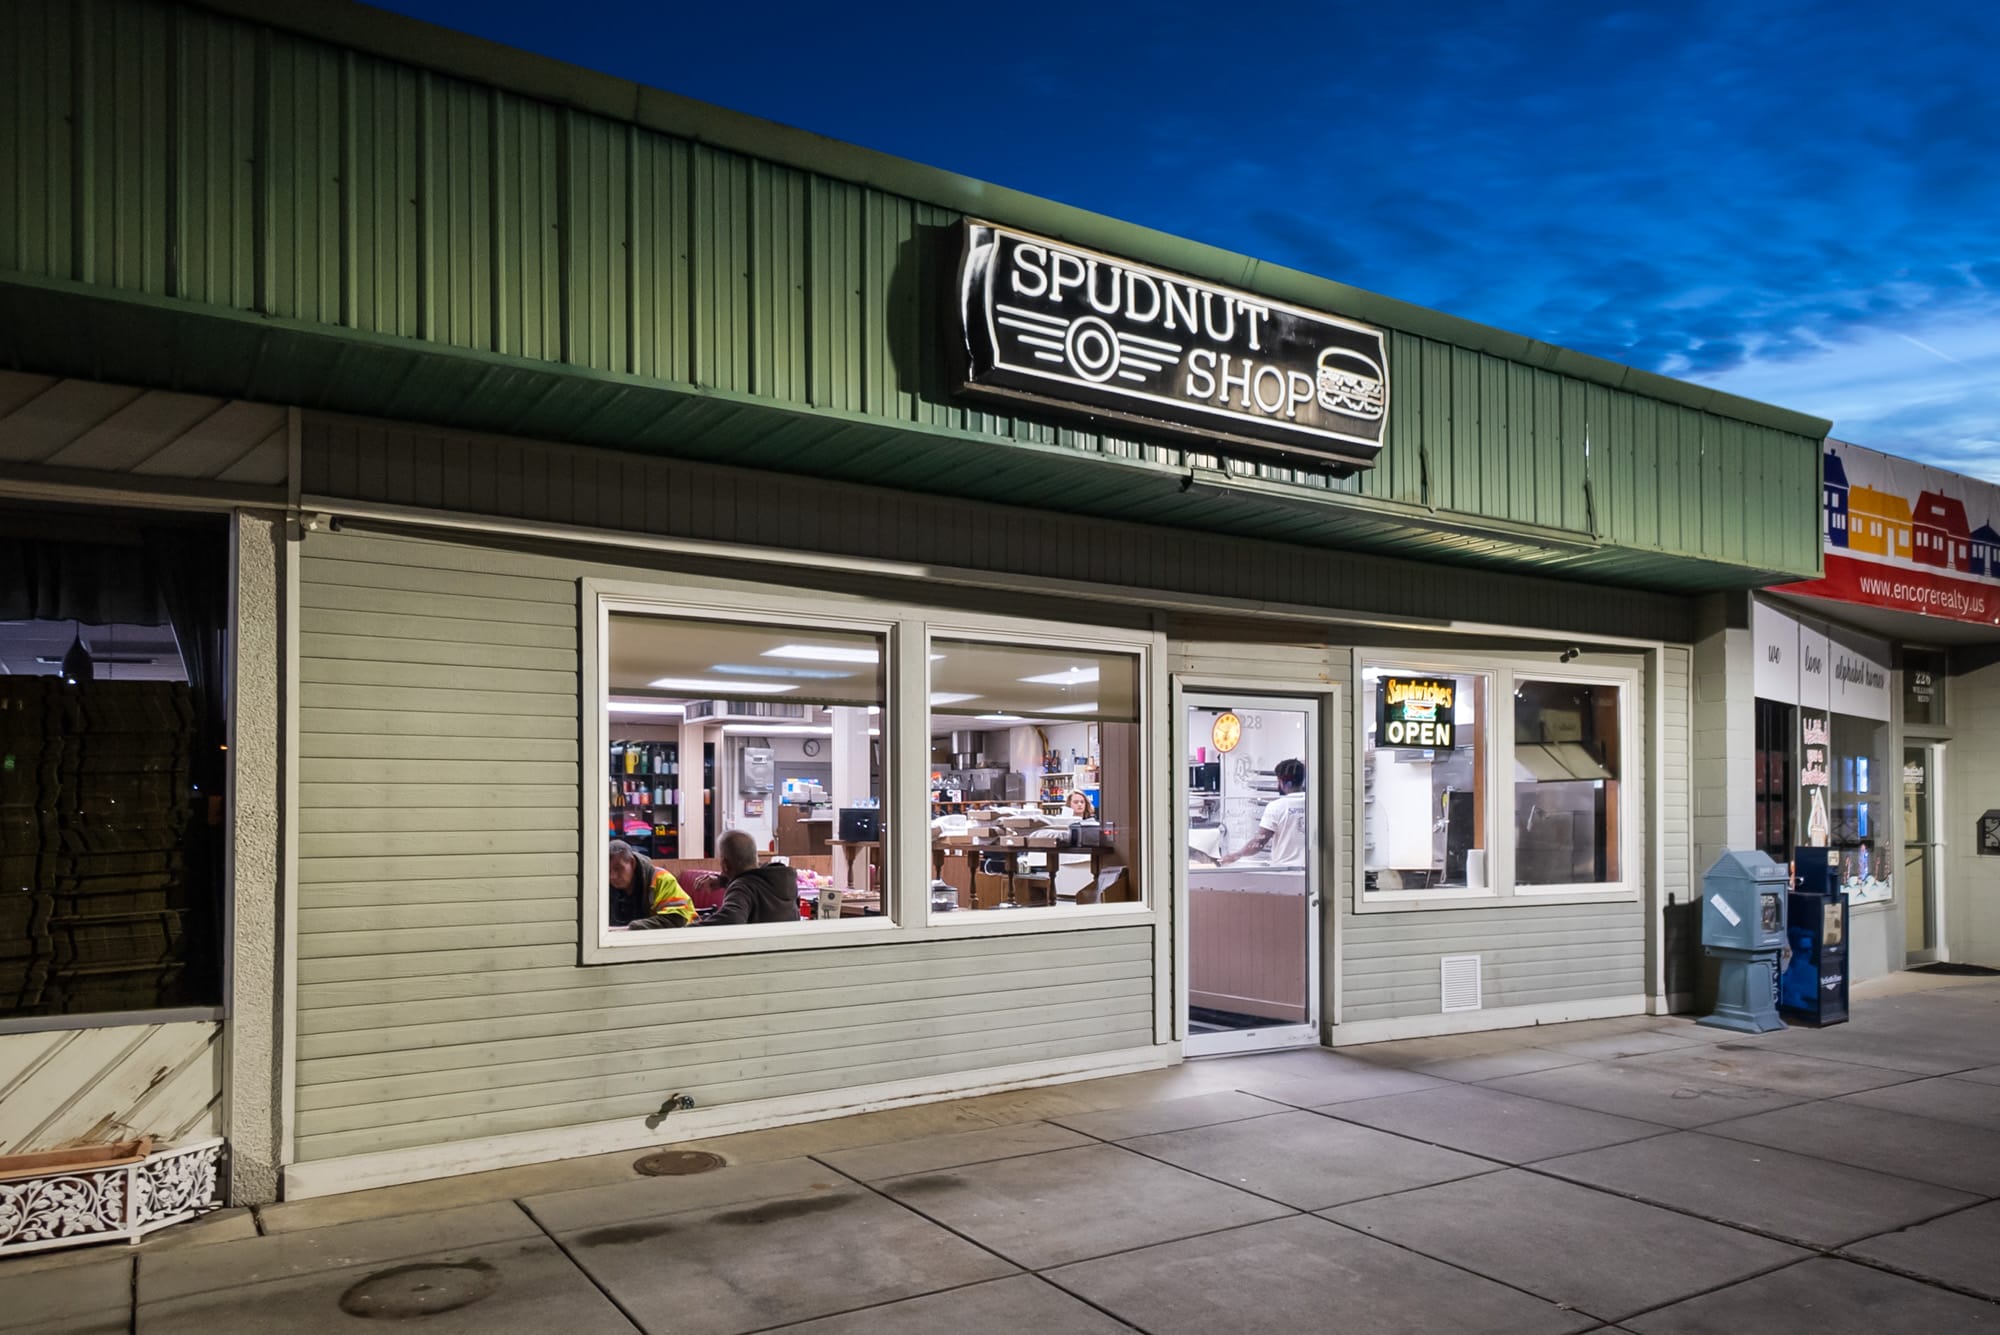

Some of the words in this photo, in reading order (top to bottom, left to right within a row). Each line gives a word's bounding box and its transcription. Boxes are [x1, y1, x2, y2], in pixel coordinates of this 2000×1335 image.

[1011, 243, 1269, 351] SPUDNUT
[1186, 348, 1315, 418] SHOP
[1859, 576, 1985, 615] www.encorerealty.us
[1768, 645, 1781, 664] we
[1804, 645, 1822, 674] love
[1387, 678, 1452, 709] Sandwiches
[1239, 714, 1262, 729] 228
[1388, 721, 1450, 746] OPEN
